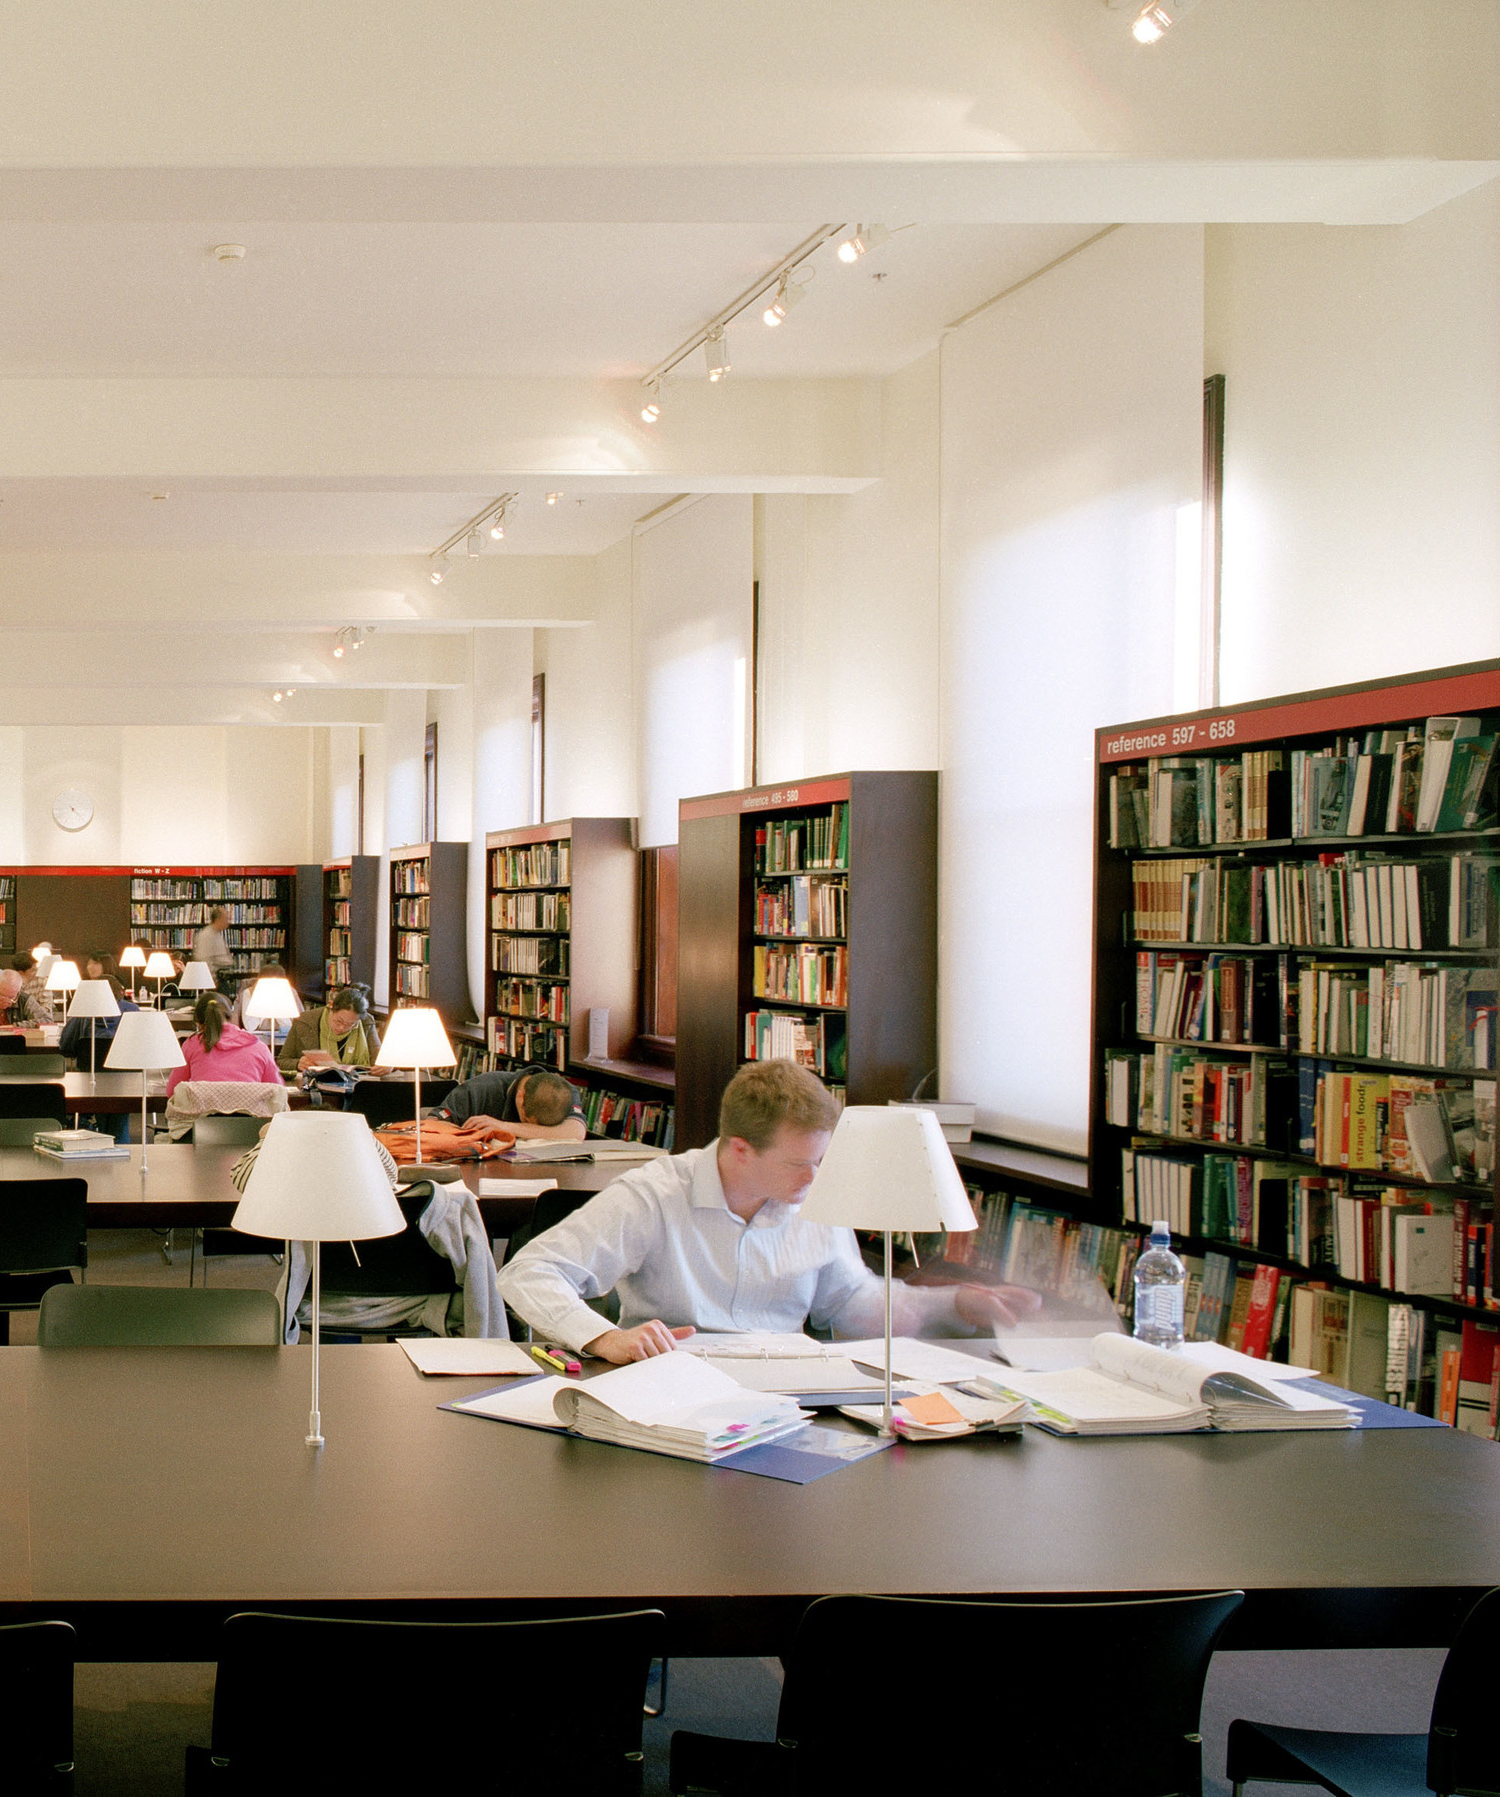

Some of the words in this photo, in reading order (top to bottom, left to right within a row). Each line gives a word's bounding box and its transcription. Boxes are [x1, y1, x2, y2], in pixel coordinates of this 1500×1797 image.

[1107, 733, 1167, 754] reference
[1172, 725, 1196, 746] 597
[1209, 719, 1236, 740] 658
[743, 795, 770, 808] reference
[1355, 1117, 1367, 1163] strange
[1155, 1289, 1176, 1331] pump
